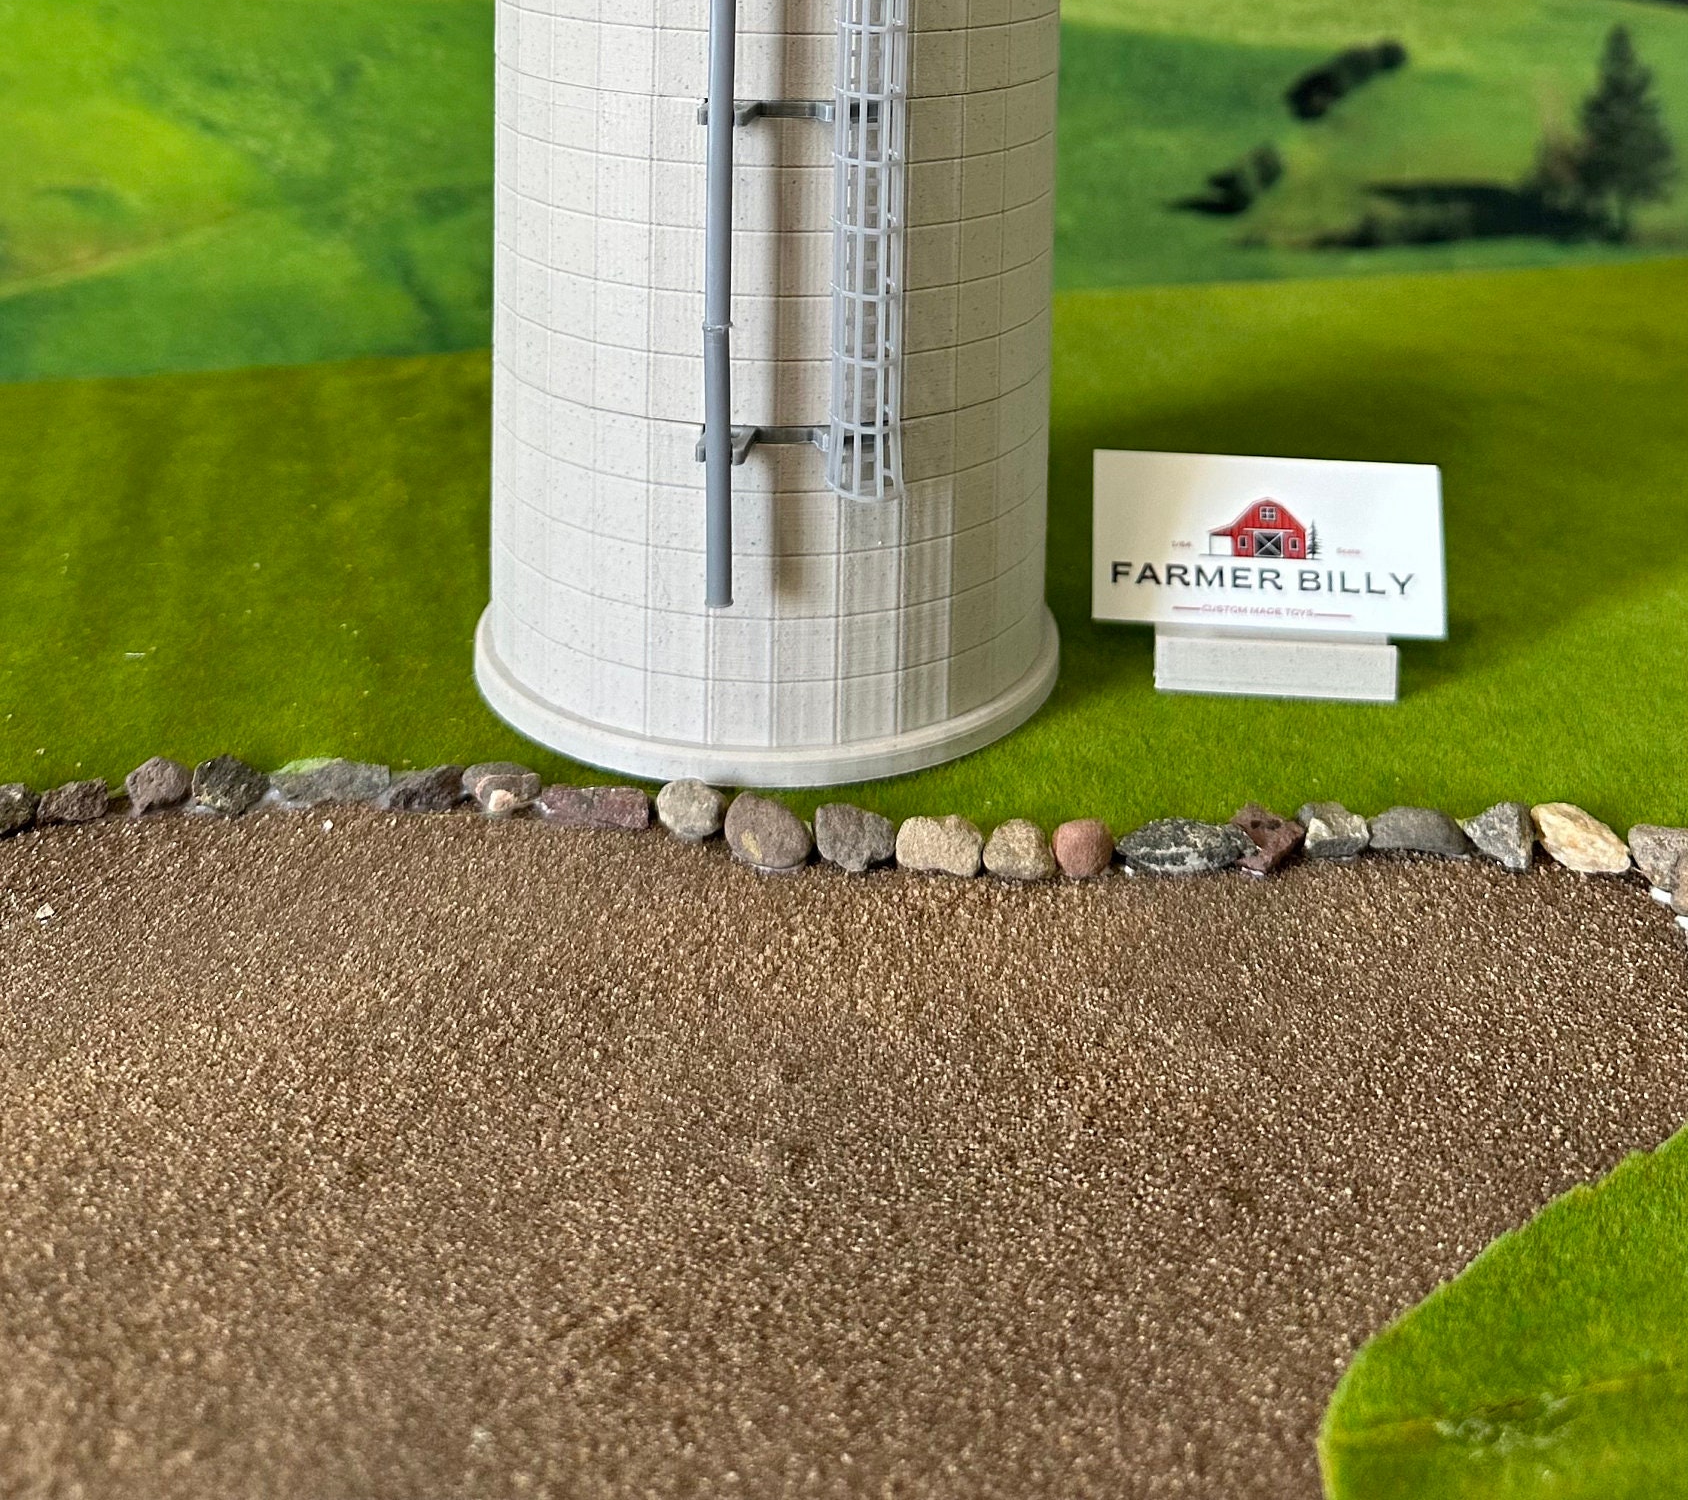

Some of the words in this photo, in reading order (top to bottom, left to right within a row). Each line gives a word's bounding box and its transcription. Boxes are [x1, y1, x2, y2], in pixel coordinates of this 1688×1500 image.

[1111, 561, 1283, 590] FARMER
[1298, 569, 1415, 595] BILLY
[1202, 604, 1248, 615] CUSTOM
[1250, 607, 1281, 617] MADE
[1285, 607, 1314, 618] TOYS
